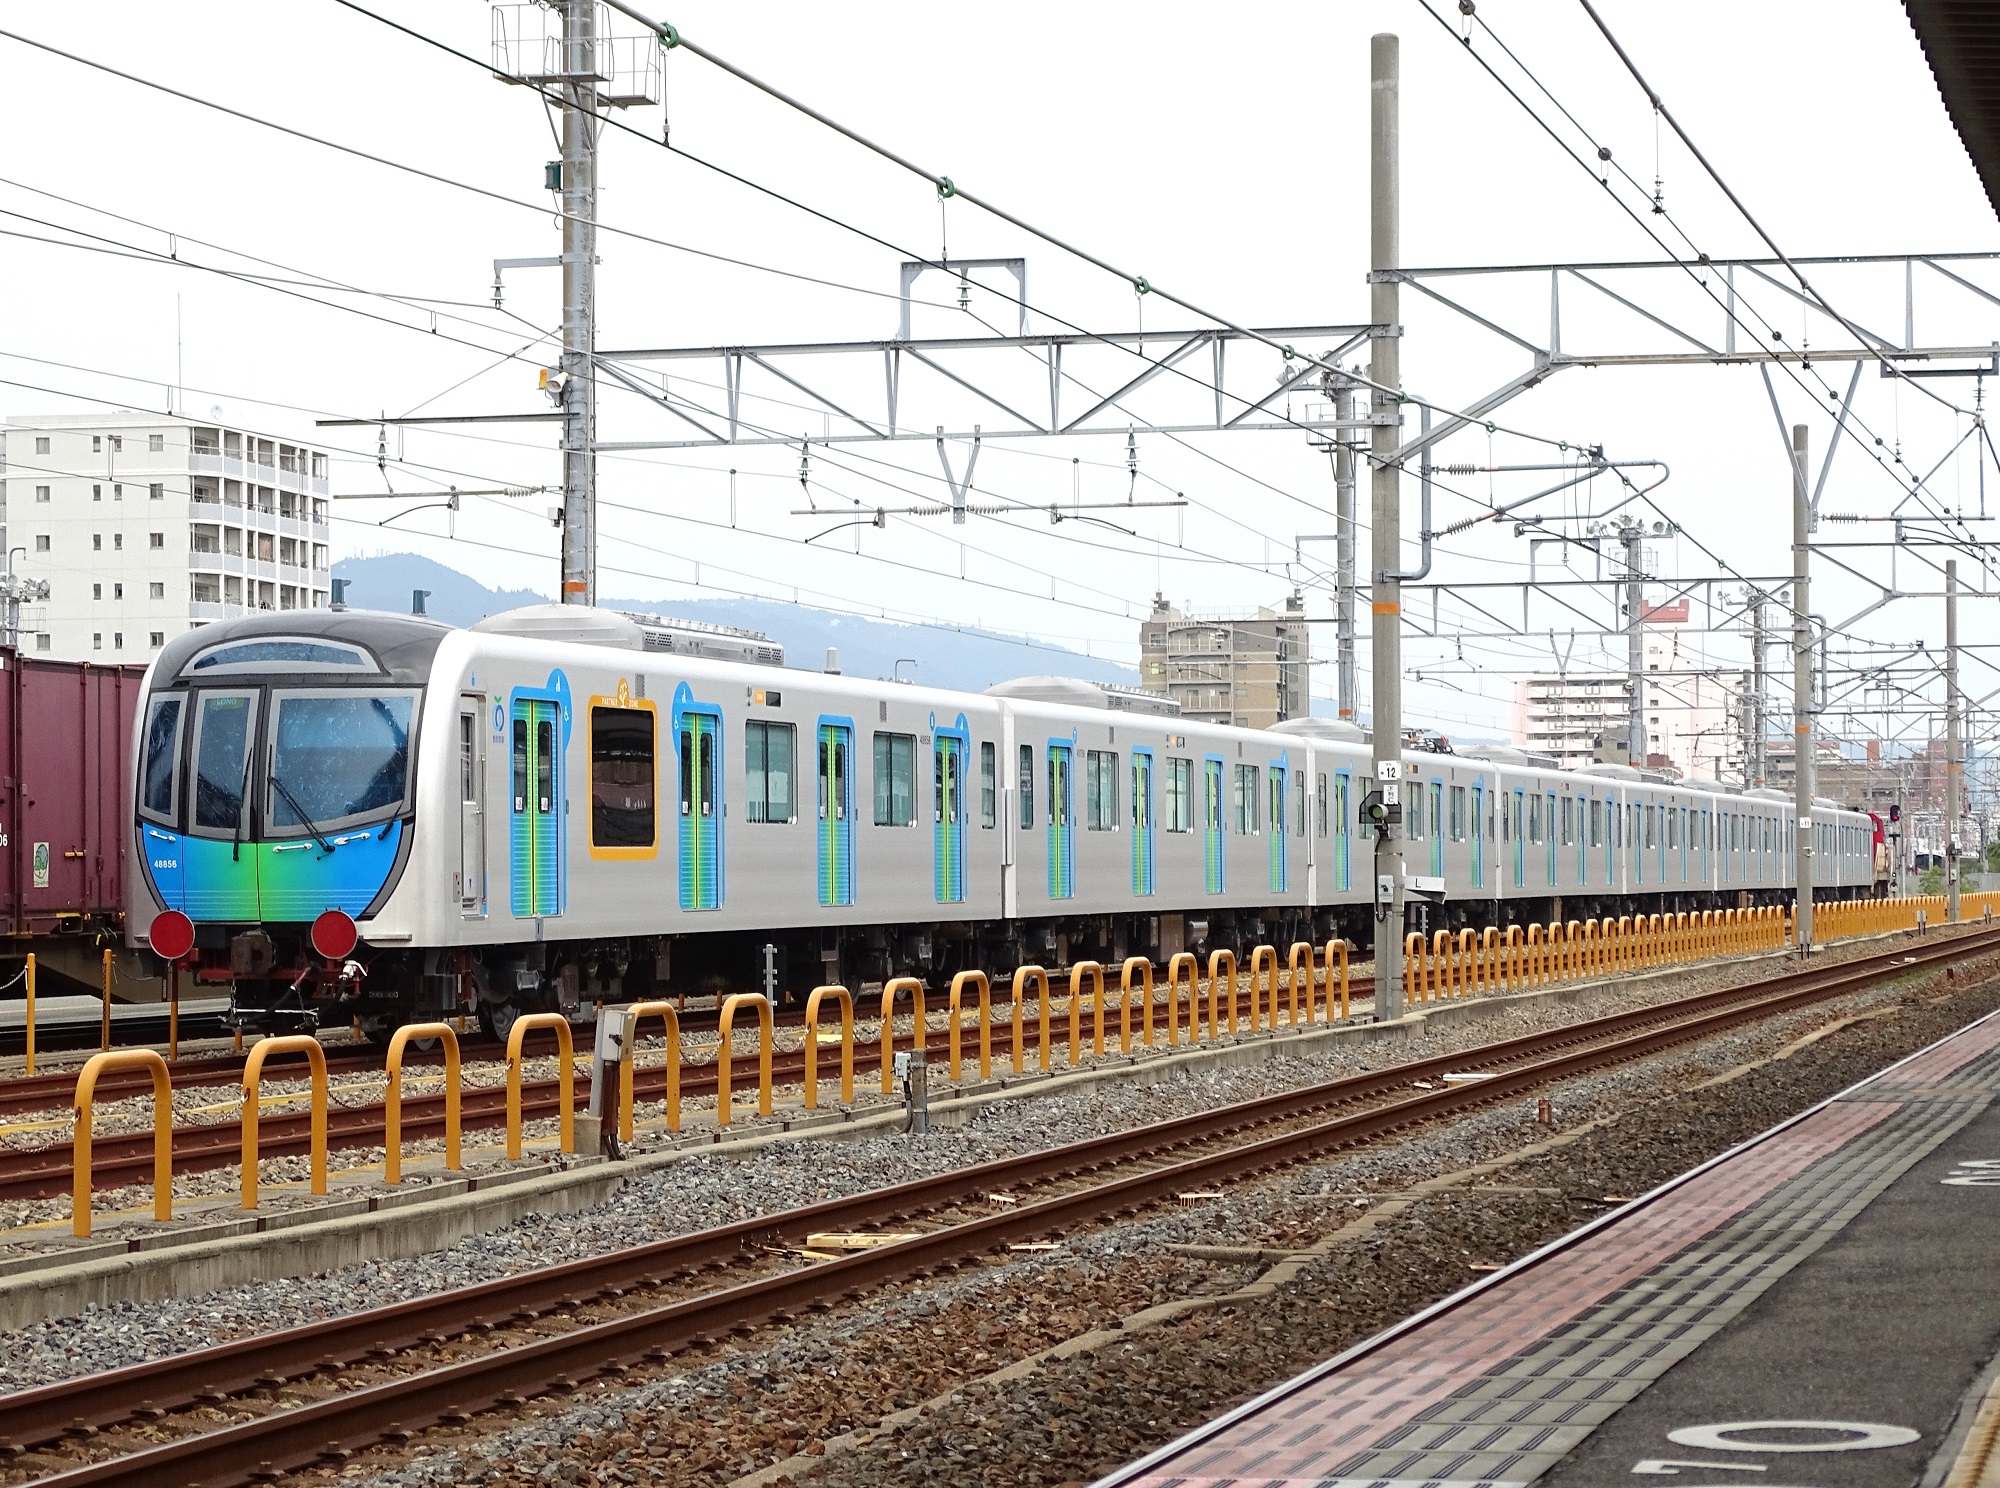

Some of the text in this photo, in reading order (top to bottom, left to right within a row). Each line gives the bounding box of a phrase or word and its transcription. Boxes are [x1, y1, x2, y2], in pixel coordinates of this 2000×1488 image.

[601, 697, 618, 706] PARTNER
[1386, 767, 1396, 778] 12
[154, 859, 177, 869] 48856
[1415, 878, 1422, 888] L
